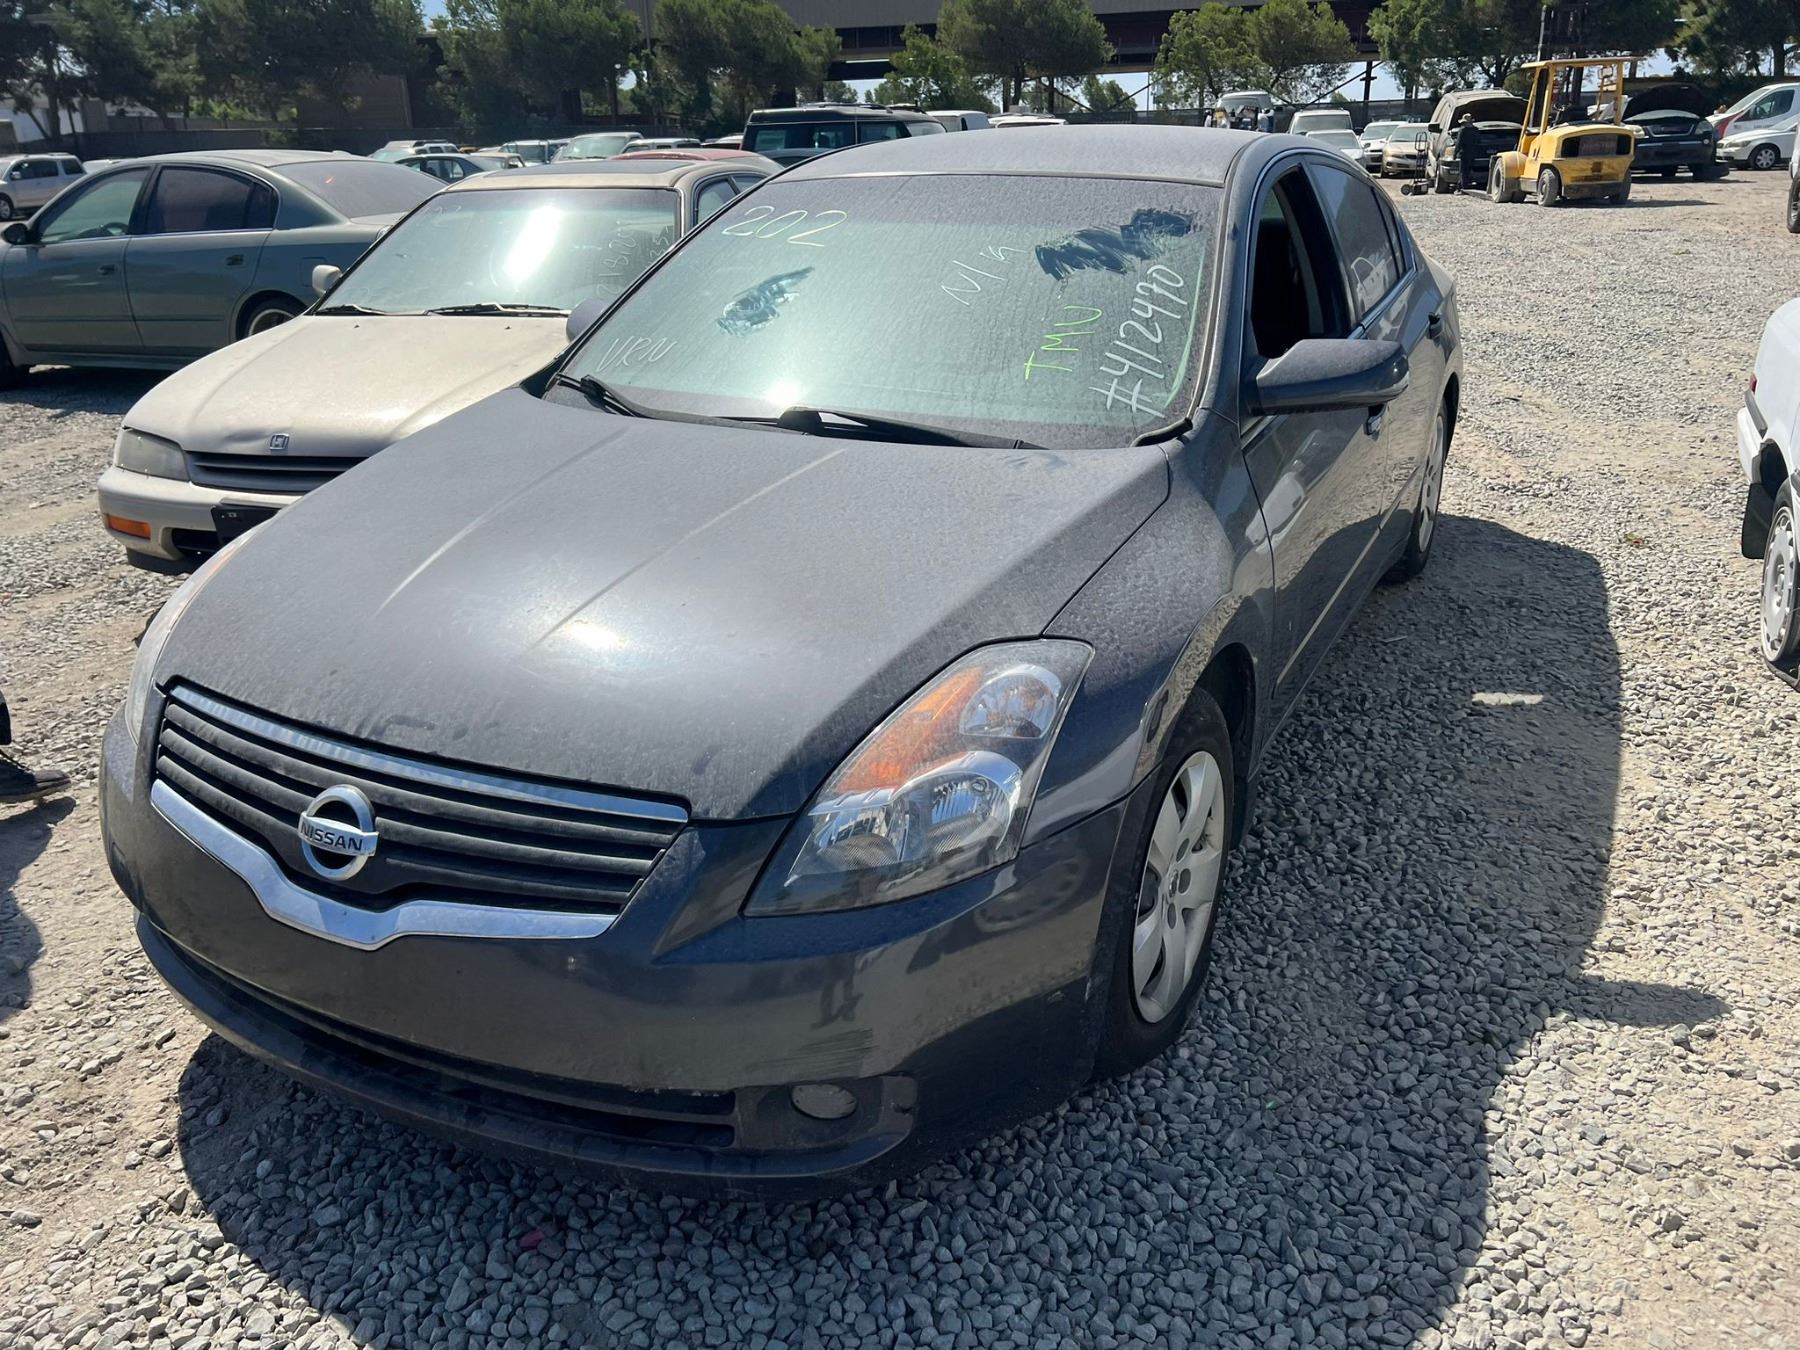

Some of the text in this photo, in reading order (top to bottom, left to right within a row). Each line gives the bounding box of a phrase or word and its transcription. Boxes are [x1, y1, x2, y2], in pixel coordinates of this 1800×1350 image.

[722, 205, 848, 247] 202
[1023, 304, 1103, 380] TMU
[1088, 264, 1188, 418] #412470
[300, 820, 363, 852] NISSAN
